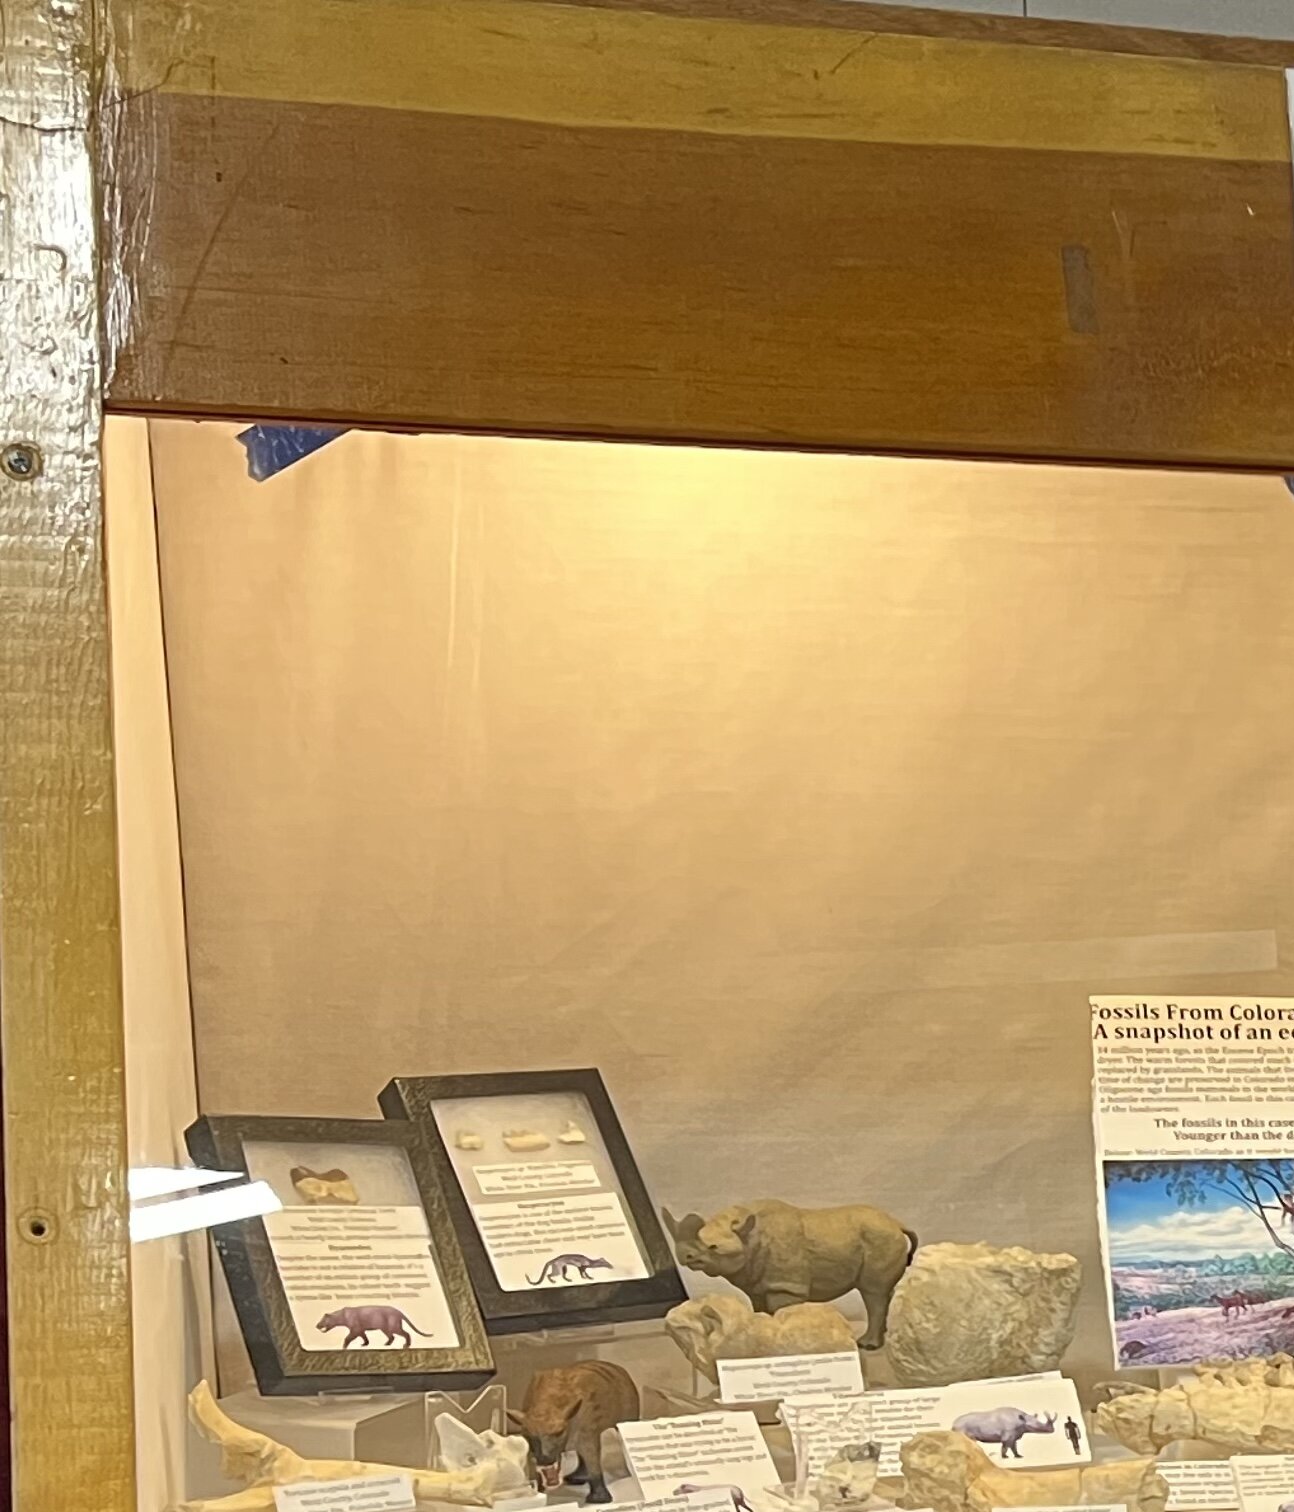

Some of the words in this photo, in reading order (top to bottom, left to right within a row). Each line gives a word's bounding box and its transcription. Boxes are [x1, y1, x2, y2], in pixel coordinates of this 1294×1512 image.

[1091, 1004, 1159, 1021] Fossils
[1167, 1005, 1223, 1020] From
[1094, 1024, 1108, 1039] A
[1115, 1023, 1213, 1043] snapshot
[1220, 1024, 1241, 1039] of
[1247, 1028, 1271, 1039] an
[1154, 1119, 1178, 1128] The
[1182, 1118, 1222, 1127] fossils
[1226, 1118, 1237, 1127] in
[1241, 1118, 1265, 1127] this
[1173, 1131, 1226, 1142] Younger
[1230, 1131, 1259, 1140] than
[1262, 1131, 1282, 1140] the
